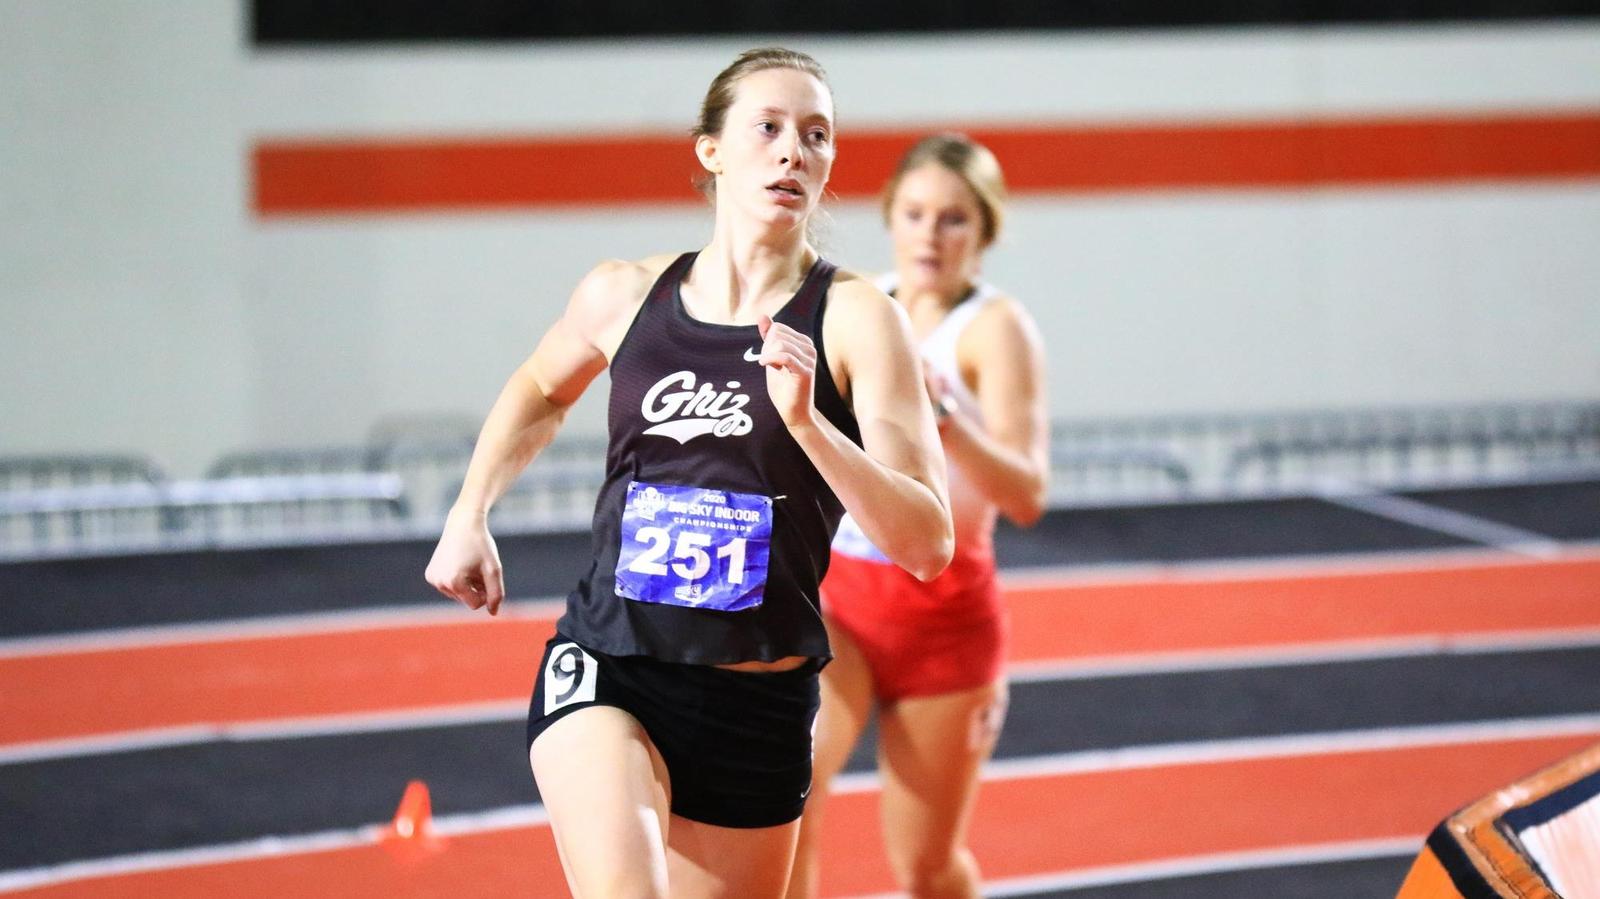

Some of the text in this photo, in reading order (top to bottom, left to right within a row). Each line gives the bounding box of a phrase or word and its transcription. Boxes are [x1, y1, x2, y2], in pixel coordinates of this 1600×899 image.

[641, 371, 753, 437] Griz
[690, 504, 714, 517] SKY
[715, 508, 760, 522] INDOOR
[704, 494, 726, 504] 2020
[674, 517, 752, 532] CHAMPIONSHIPS
[629, 527, 747, 584] 251
[552, 647, 584, 704] 9
